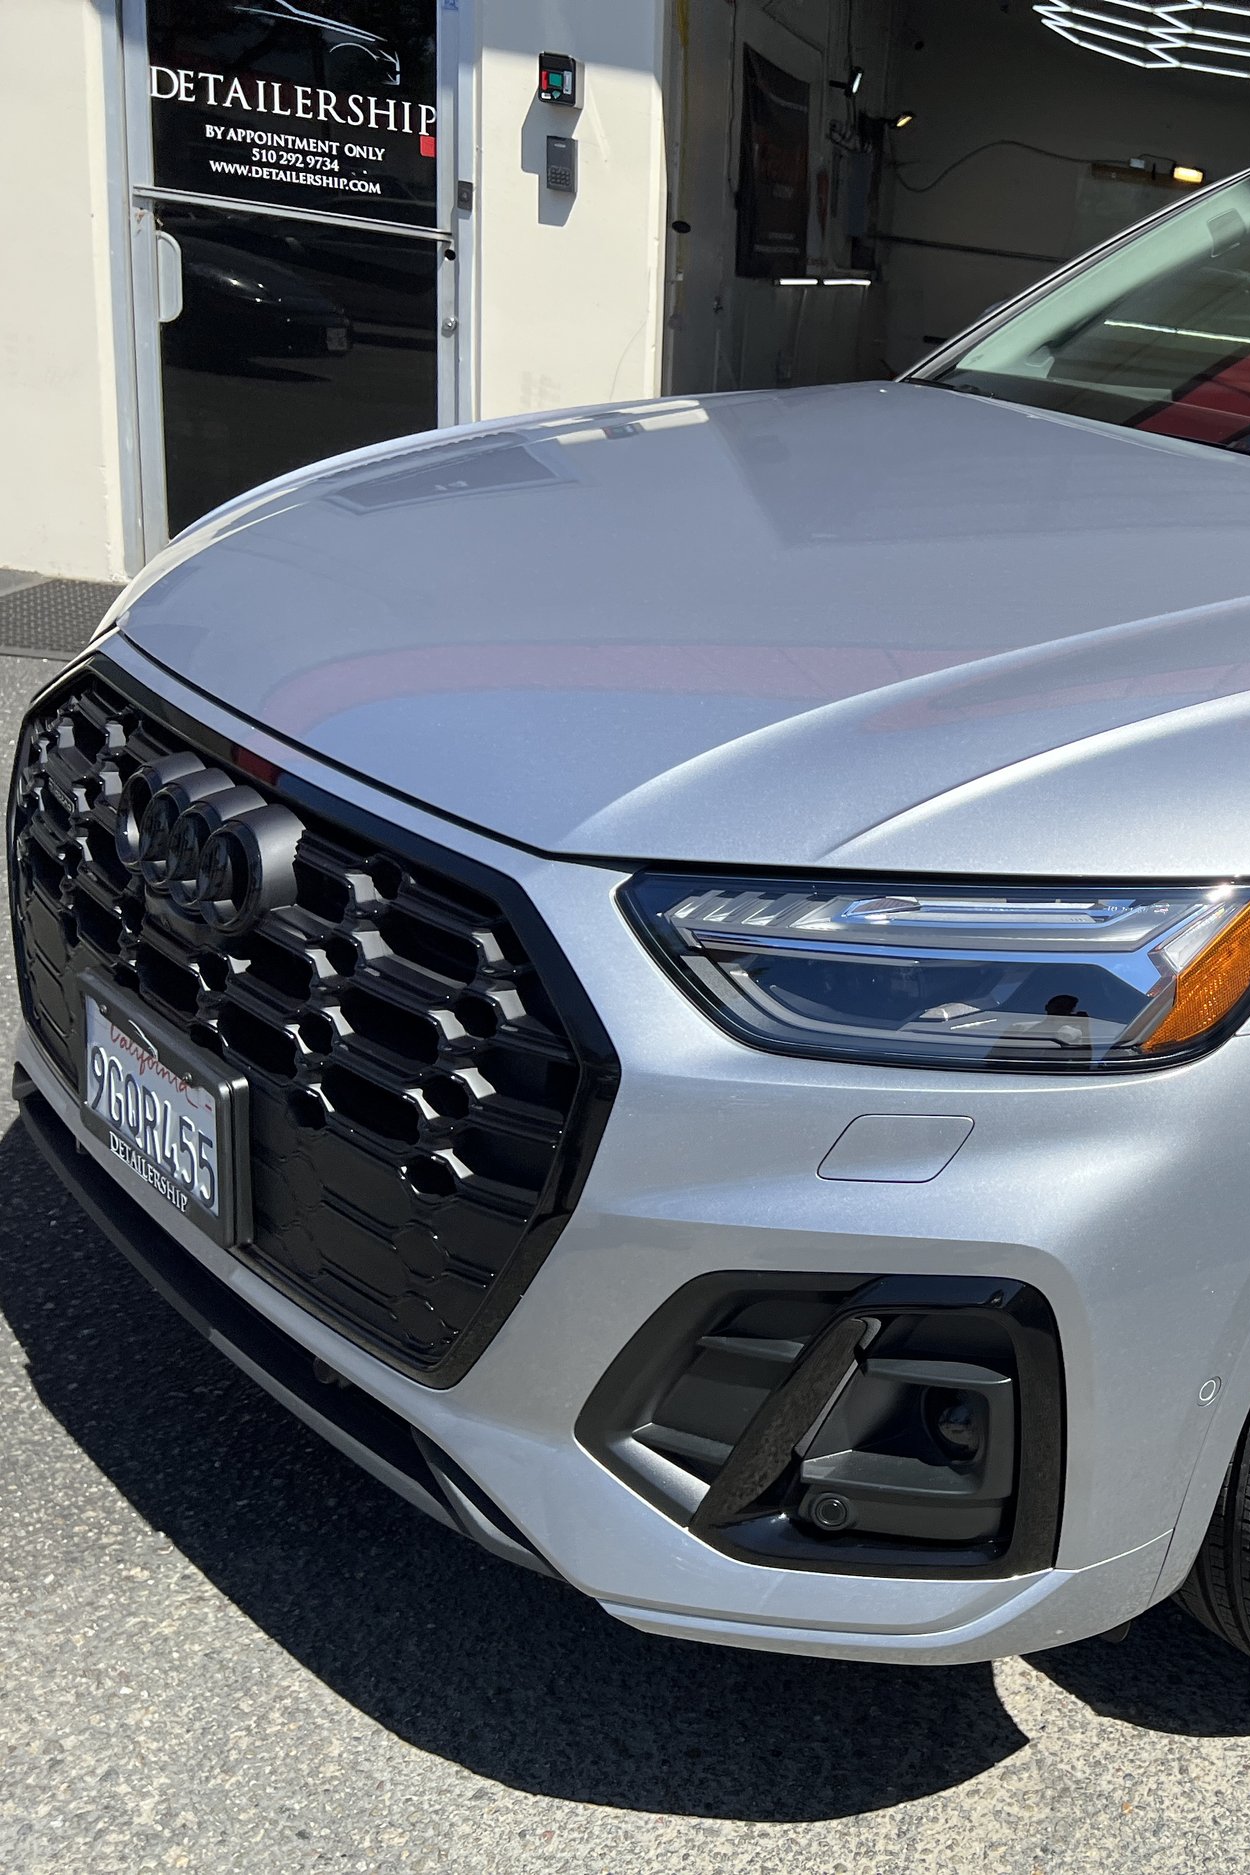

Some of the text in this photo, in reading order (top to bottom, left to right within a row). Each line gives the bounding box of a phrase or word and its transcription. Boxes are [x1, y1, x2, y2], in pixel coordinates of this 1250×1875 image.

[150, 65, 437, 136] DETAILERSHIP
[205, 124, 385, 161] BY APPOINTMENT ONLY
[251, 148, 339, 172] 510 292 9734
[209, 160, 382, 194] WWW.DETAILERSHIP.COM
[91, 1045, 216, 1209] 9GQR455
[109, 1131, 188, 1213] DETAILERSHIP
